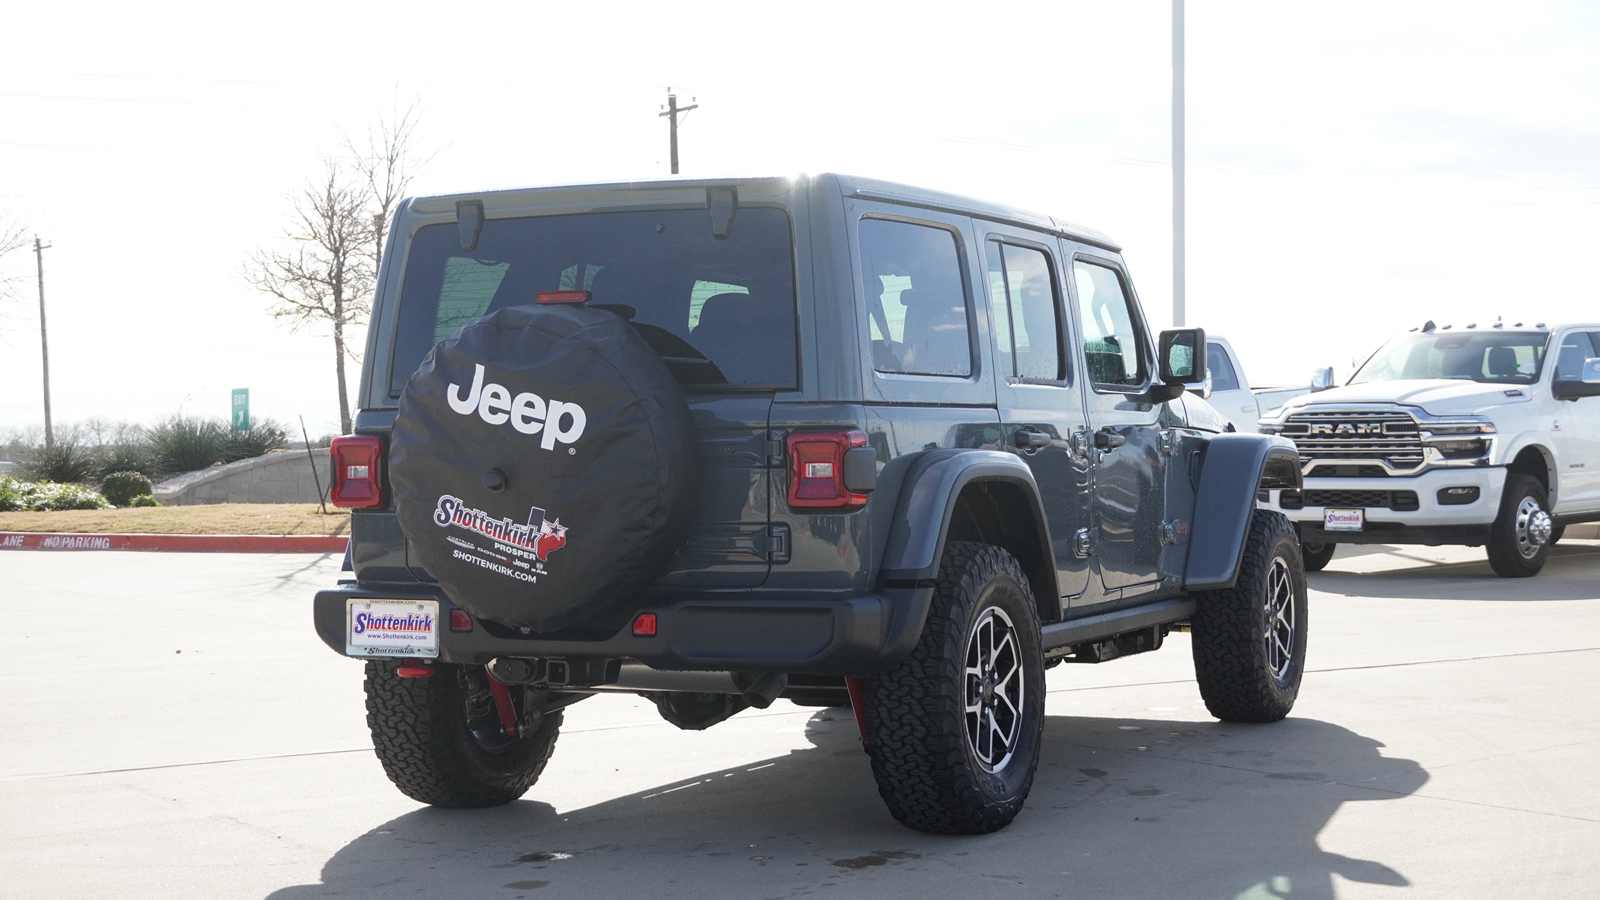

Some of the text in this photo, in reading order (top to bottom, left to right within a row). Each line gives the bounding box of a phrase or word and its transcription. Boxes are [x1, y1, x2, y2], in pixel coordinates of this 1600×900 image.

[234, 394, 246, 405] EXIT
[447, 363, 587, 451] Jeep
[1312, 423, 1381, 434] RAM
[434, 494, 543, 551] Shottenkirk
[43, 536, 60, 548] NO
[61, 536, 110, 549] PARKING
[494, 542, 536, 561] PROSPER
[452, 549, 537, 584] SHOTTENKIRK.COM
[512, 558, 530, 569] Jeep
[531, 568, 548, 576] RAM
[354, 612, 434, 634] Shottenkirk
